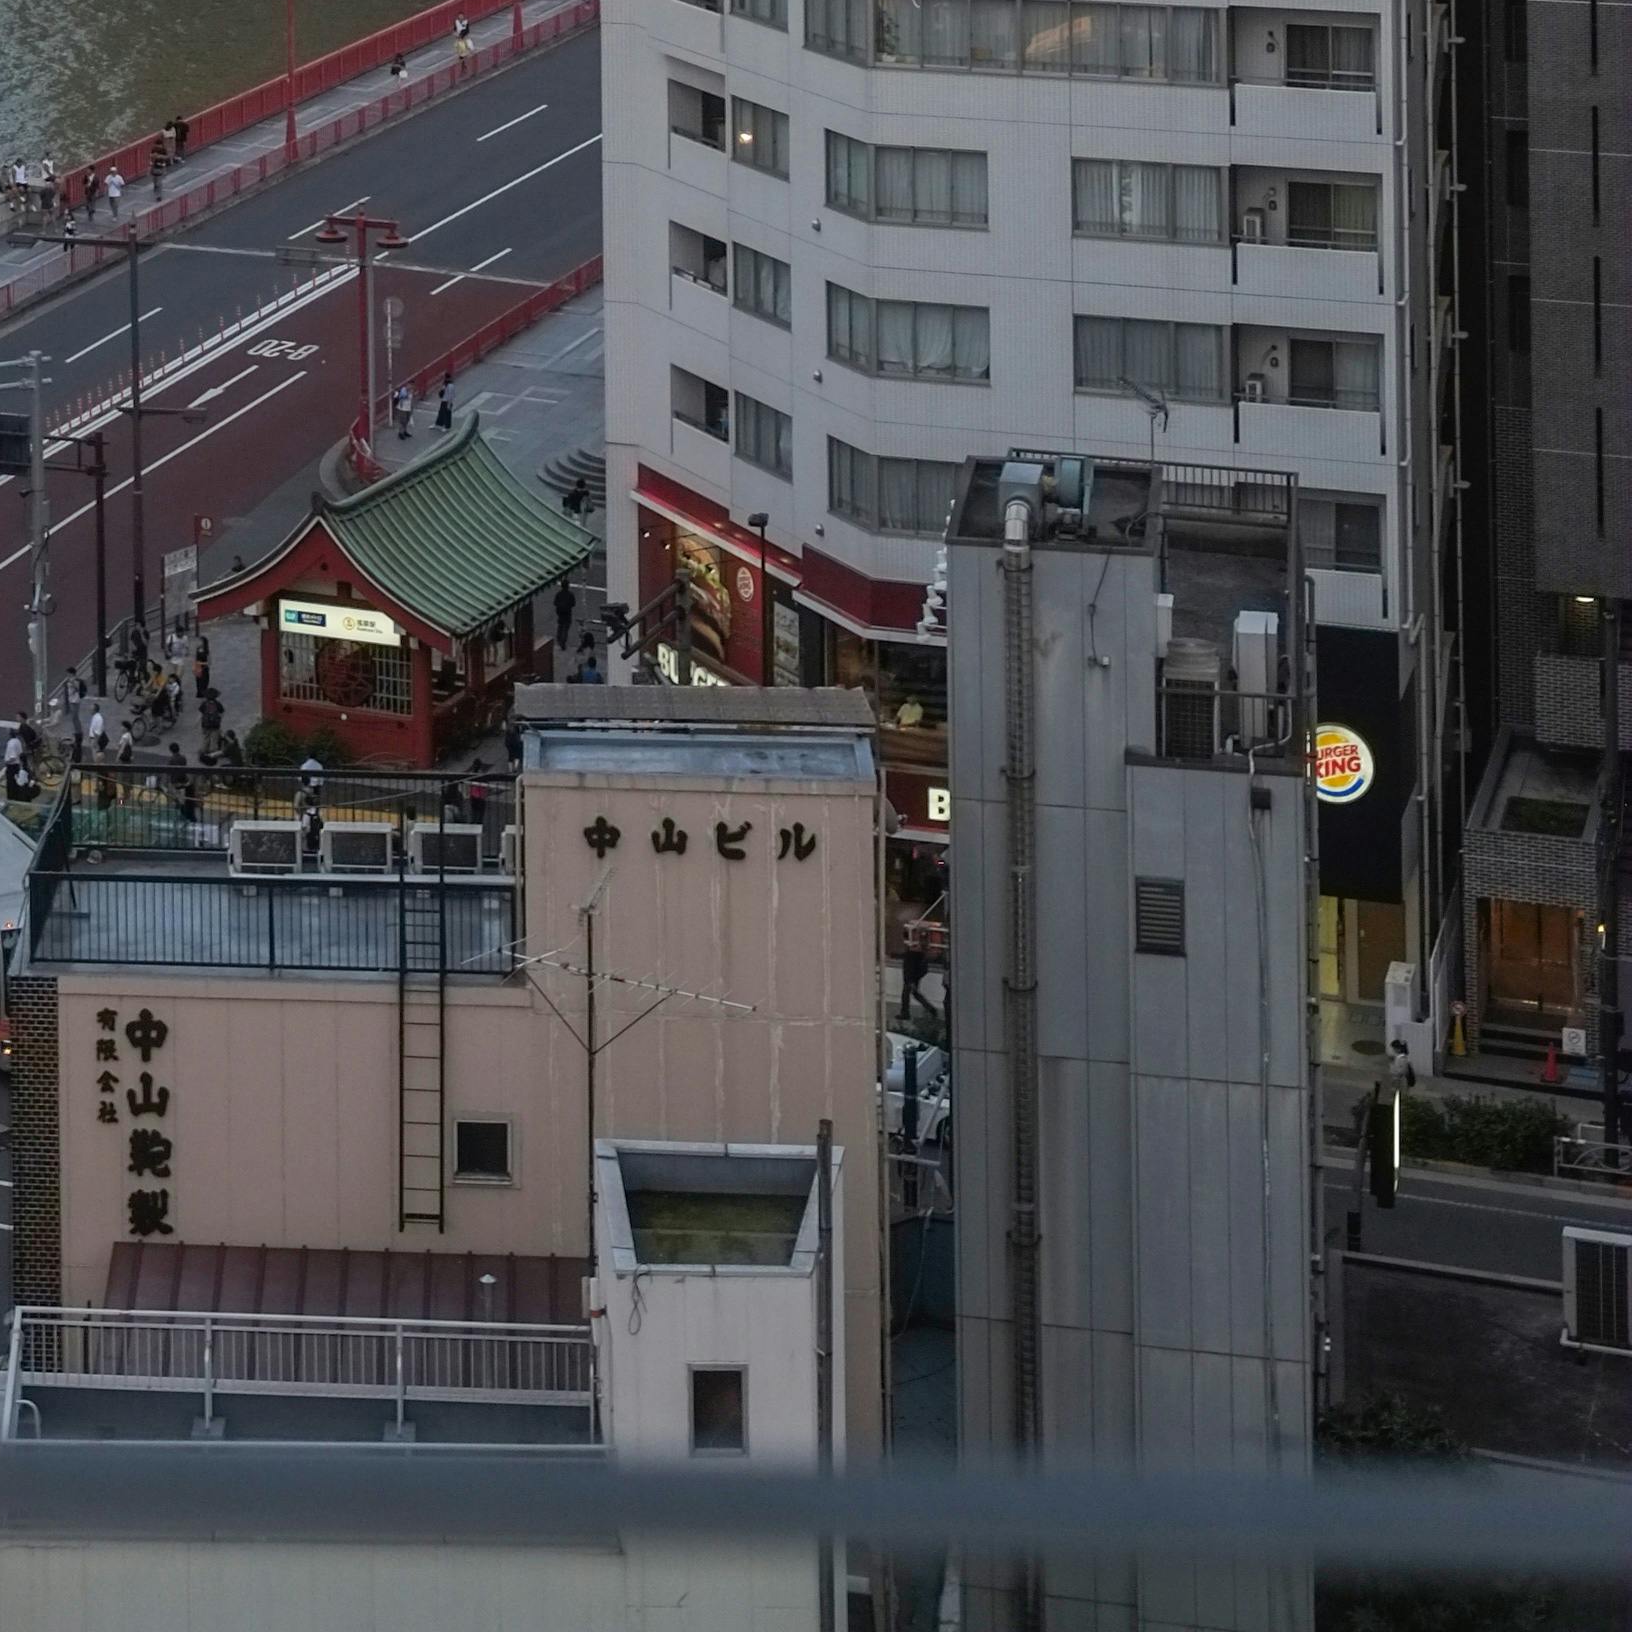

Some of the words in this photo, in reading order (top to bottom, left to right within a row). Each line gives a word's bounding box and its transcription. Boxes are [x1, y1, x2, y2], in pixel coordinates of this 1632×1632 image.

[1316, 744, 1359, 761] URGER
[584, 816, 816, 861] 中山ビル
[96, 1008, 119, 1124] 有限会社
